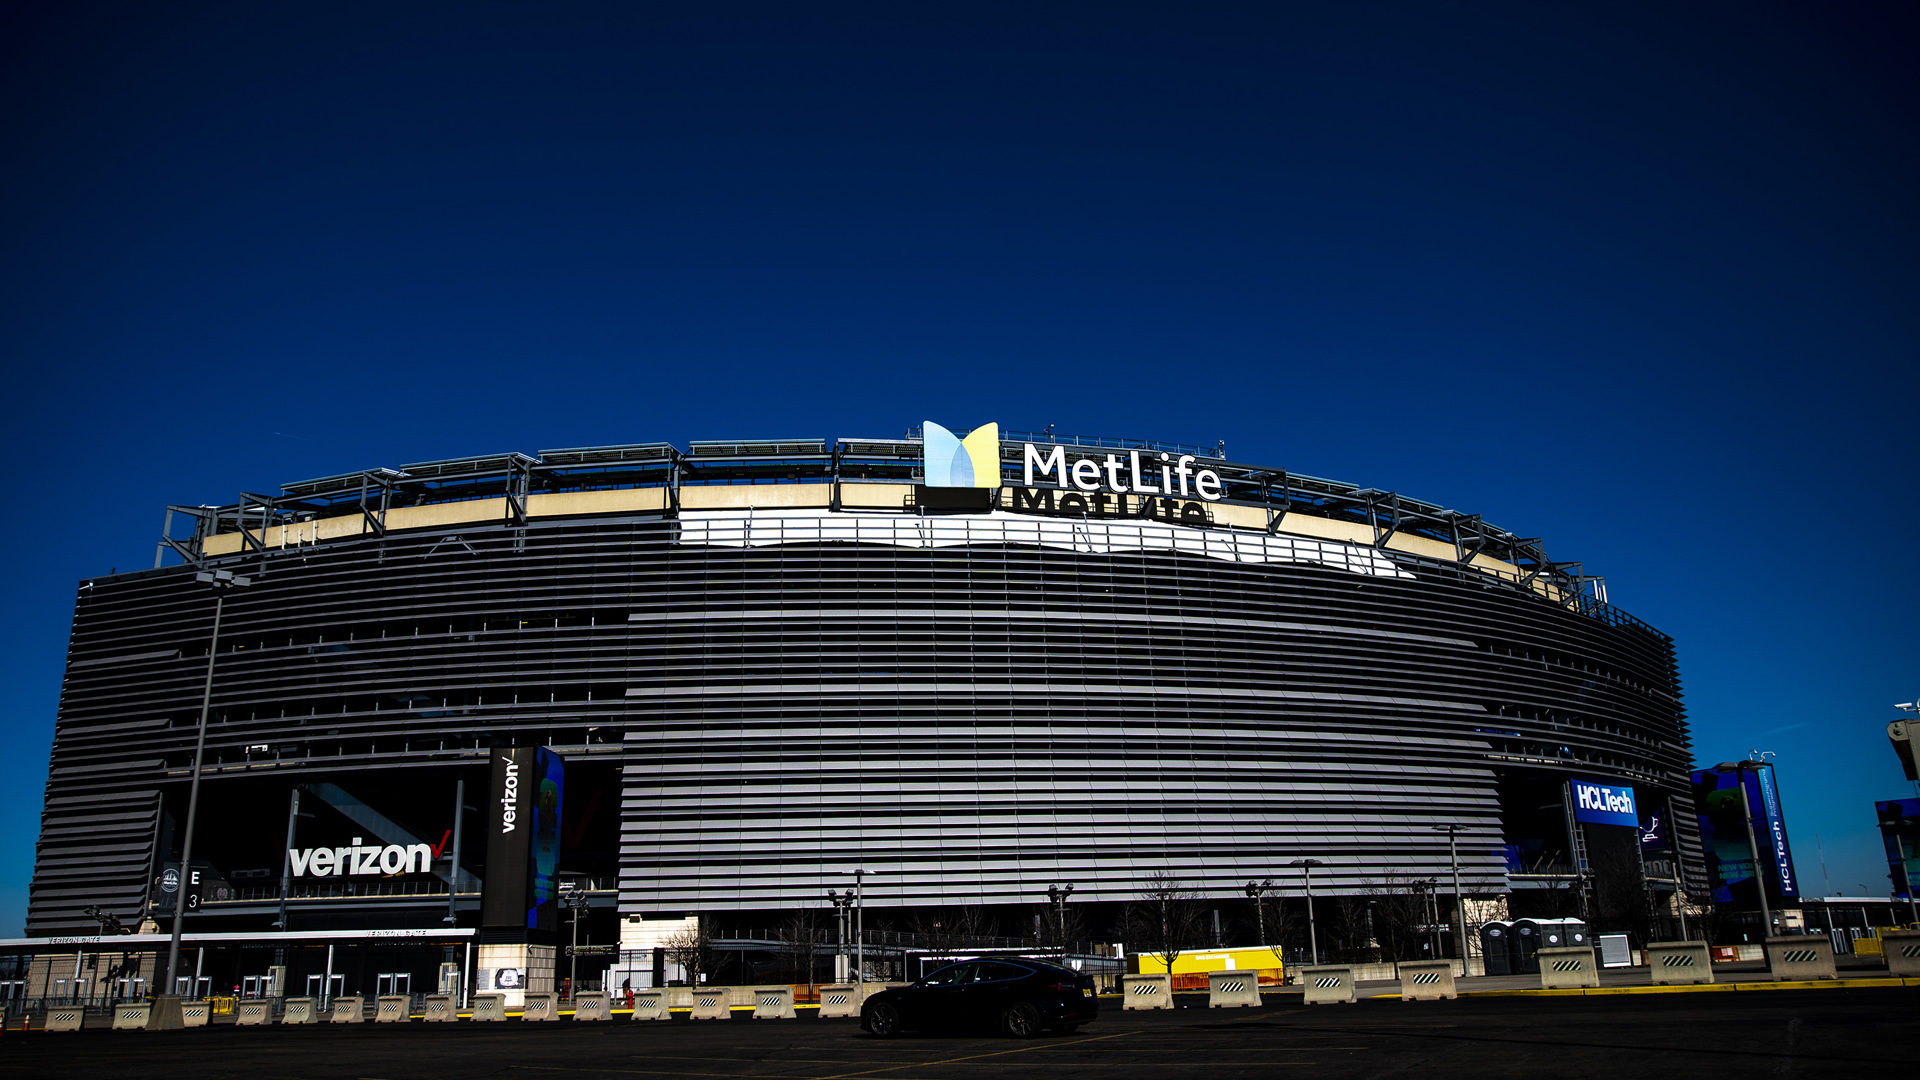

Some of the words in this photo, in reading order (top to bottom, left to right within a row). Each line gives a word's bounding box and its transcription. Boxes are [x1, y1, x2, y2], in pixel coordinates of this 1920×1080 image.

[1023, 443, 1222, 501] MetLife
[501, 763, 519, 834] verizon
[1577, 784, 1633, 814] HCLTech
[289, 837, 432, 877] verizon
[1773, 821, 1793, 892] HCLTech
[190, 871, 201, 885] E
[188, 894, 198, 908] 3
